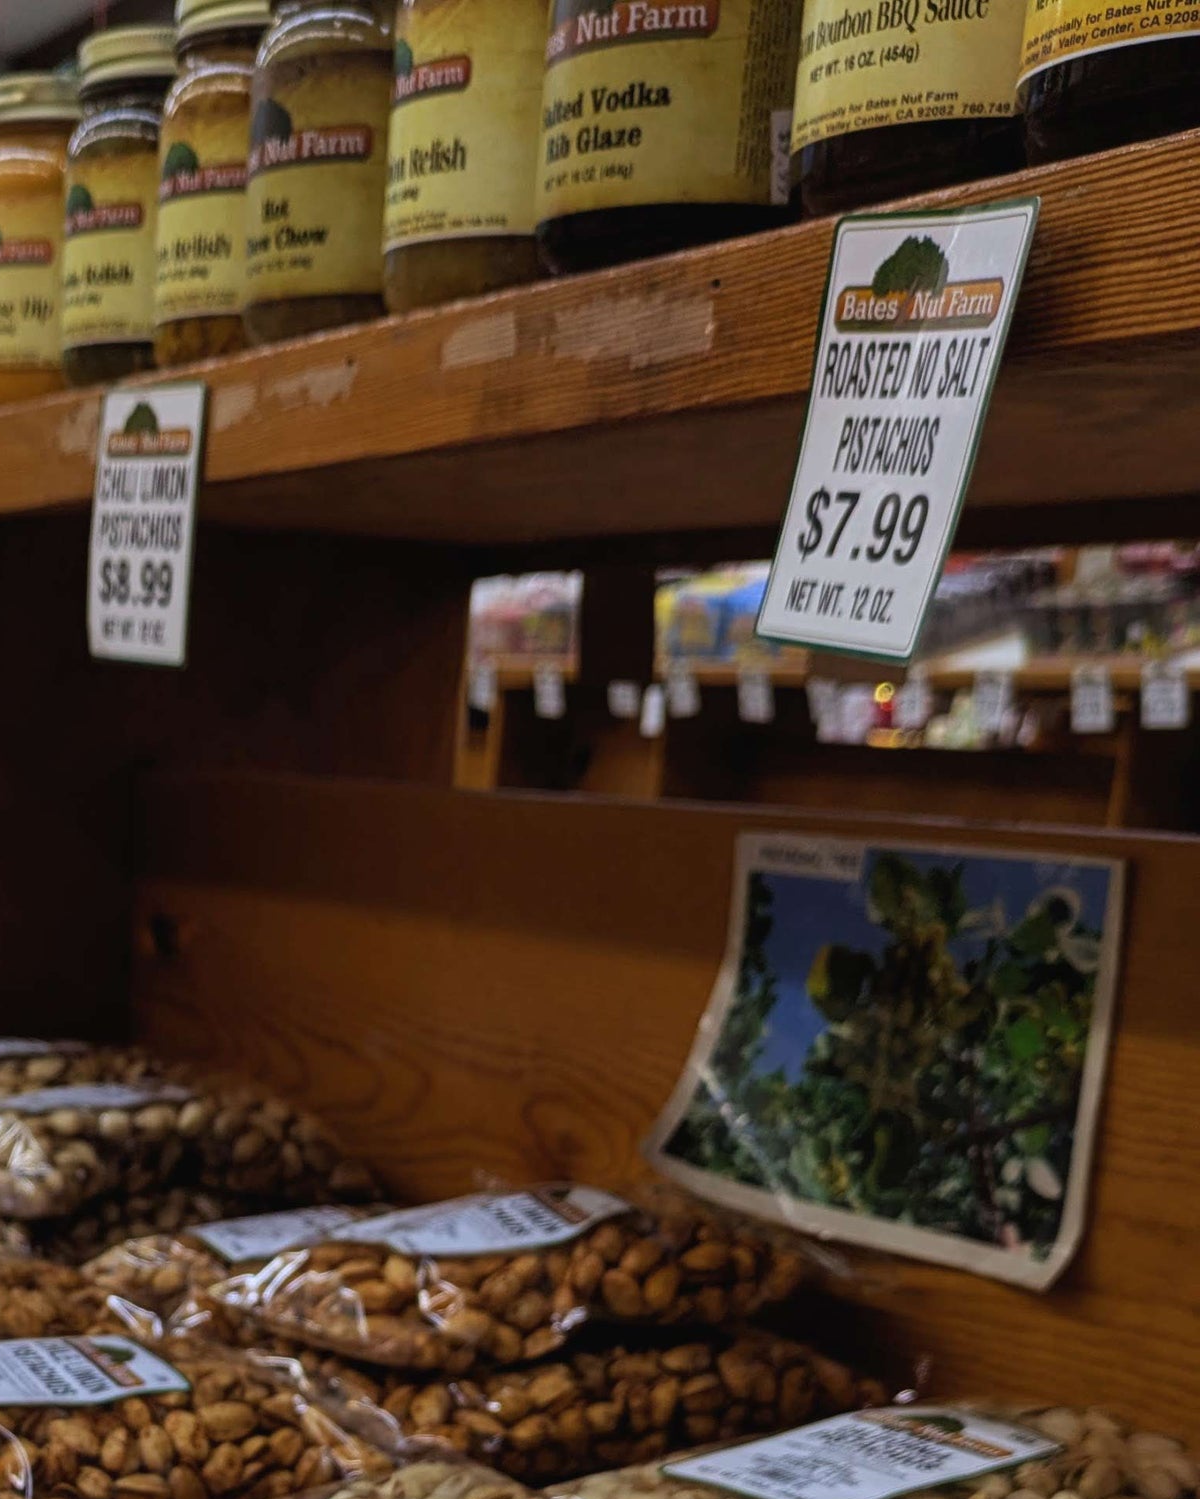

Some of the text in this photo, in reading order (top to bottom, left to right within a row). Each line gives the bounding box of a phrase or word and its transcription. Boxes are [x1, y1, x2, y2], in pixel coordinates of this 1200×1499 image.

[576, 13, 620, 44] Nut
[627, 1, 709, 32] Farm
[816, 9, 871, 51] Bourbon
[877, 0, 916, 33] BBQ
[924, 0, 989, 24] Sauce
[1086, 0, 1172, 25] for Bates Nut
[1059, 32, 1089, 49] Valley
[1091, 21, 1136, 40] Center,
[1139, 15, 1161, 30] CA
[857, 49, 877, 69] OZ.
[418, 66, 464, 91] Farm
[590, 81, 671, 114] Vodka
[895, 107, 914, 121] CA
[901, 92, 923, 105] Nut
[925, 90, 959, 102] Farm
[301, 132, 364, 157] Farm
[576, 124, 643, 154] Glaze
[409, 138, 468, 178] Relish
[841, 287, 994, 321] Bates Nut Farm
[820, 336, 992, 399] ROASTED NO SALT
[832, 416, 941, 477] PISTACHIOS
[796, 485, 930, 566] $7.99
[100, 557, 174, 608] $8.99
[784, 576, 896, 624] NET WT. 12 OZ.
